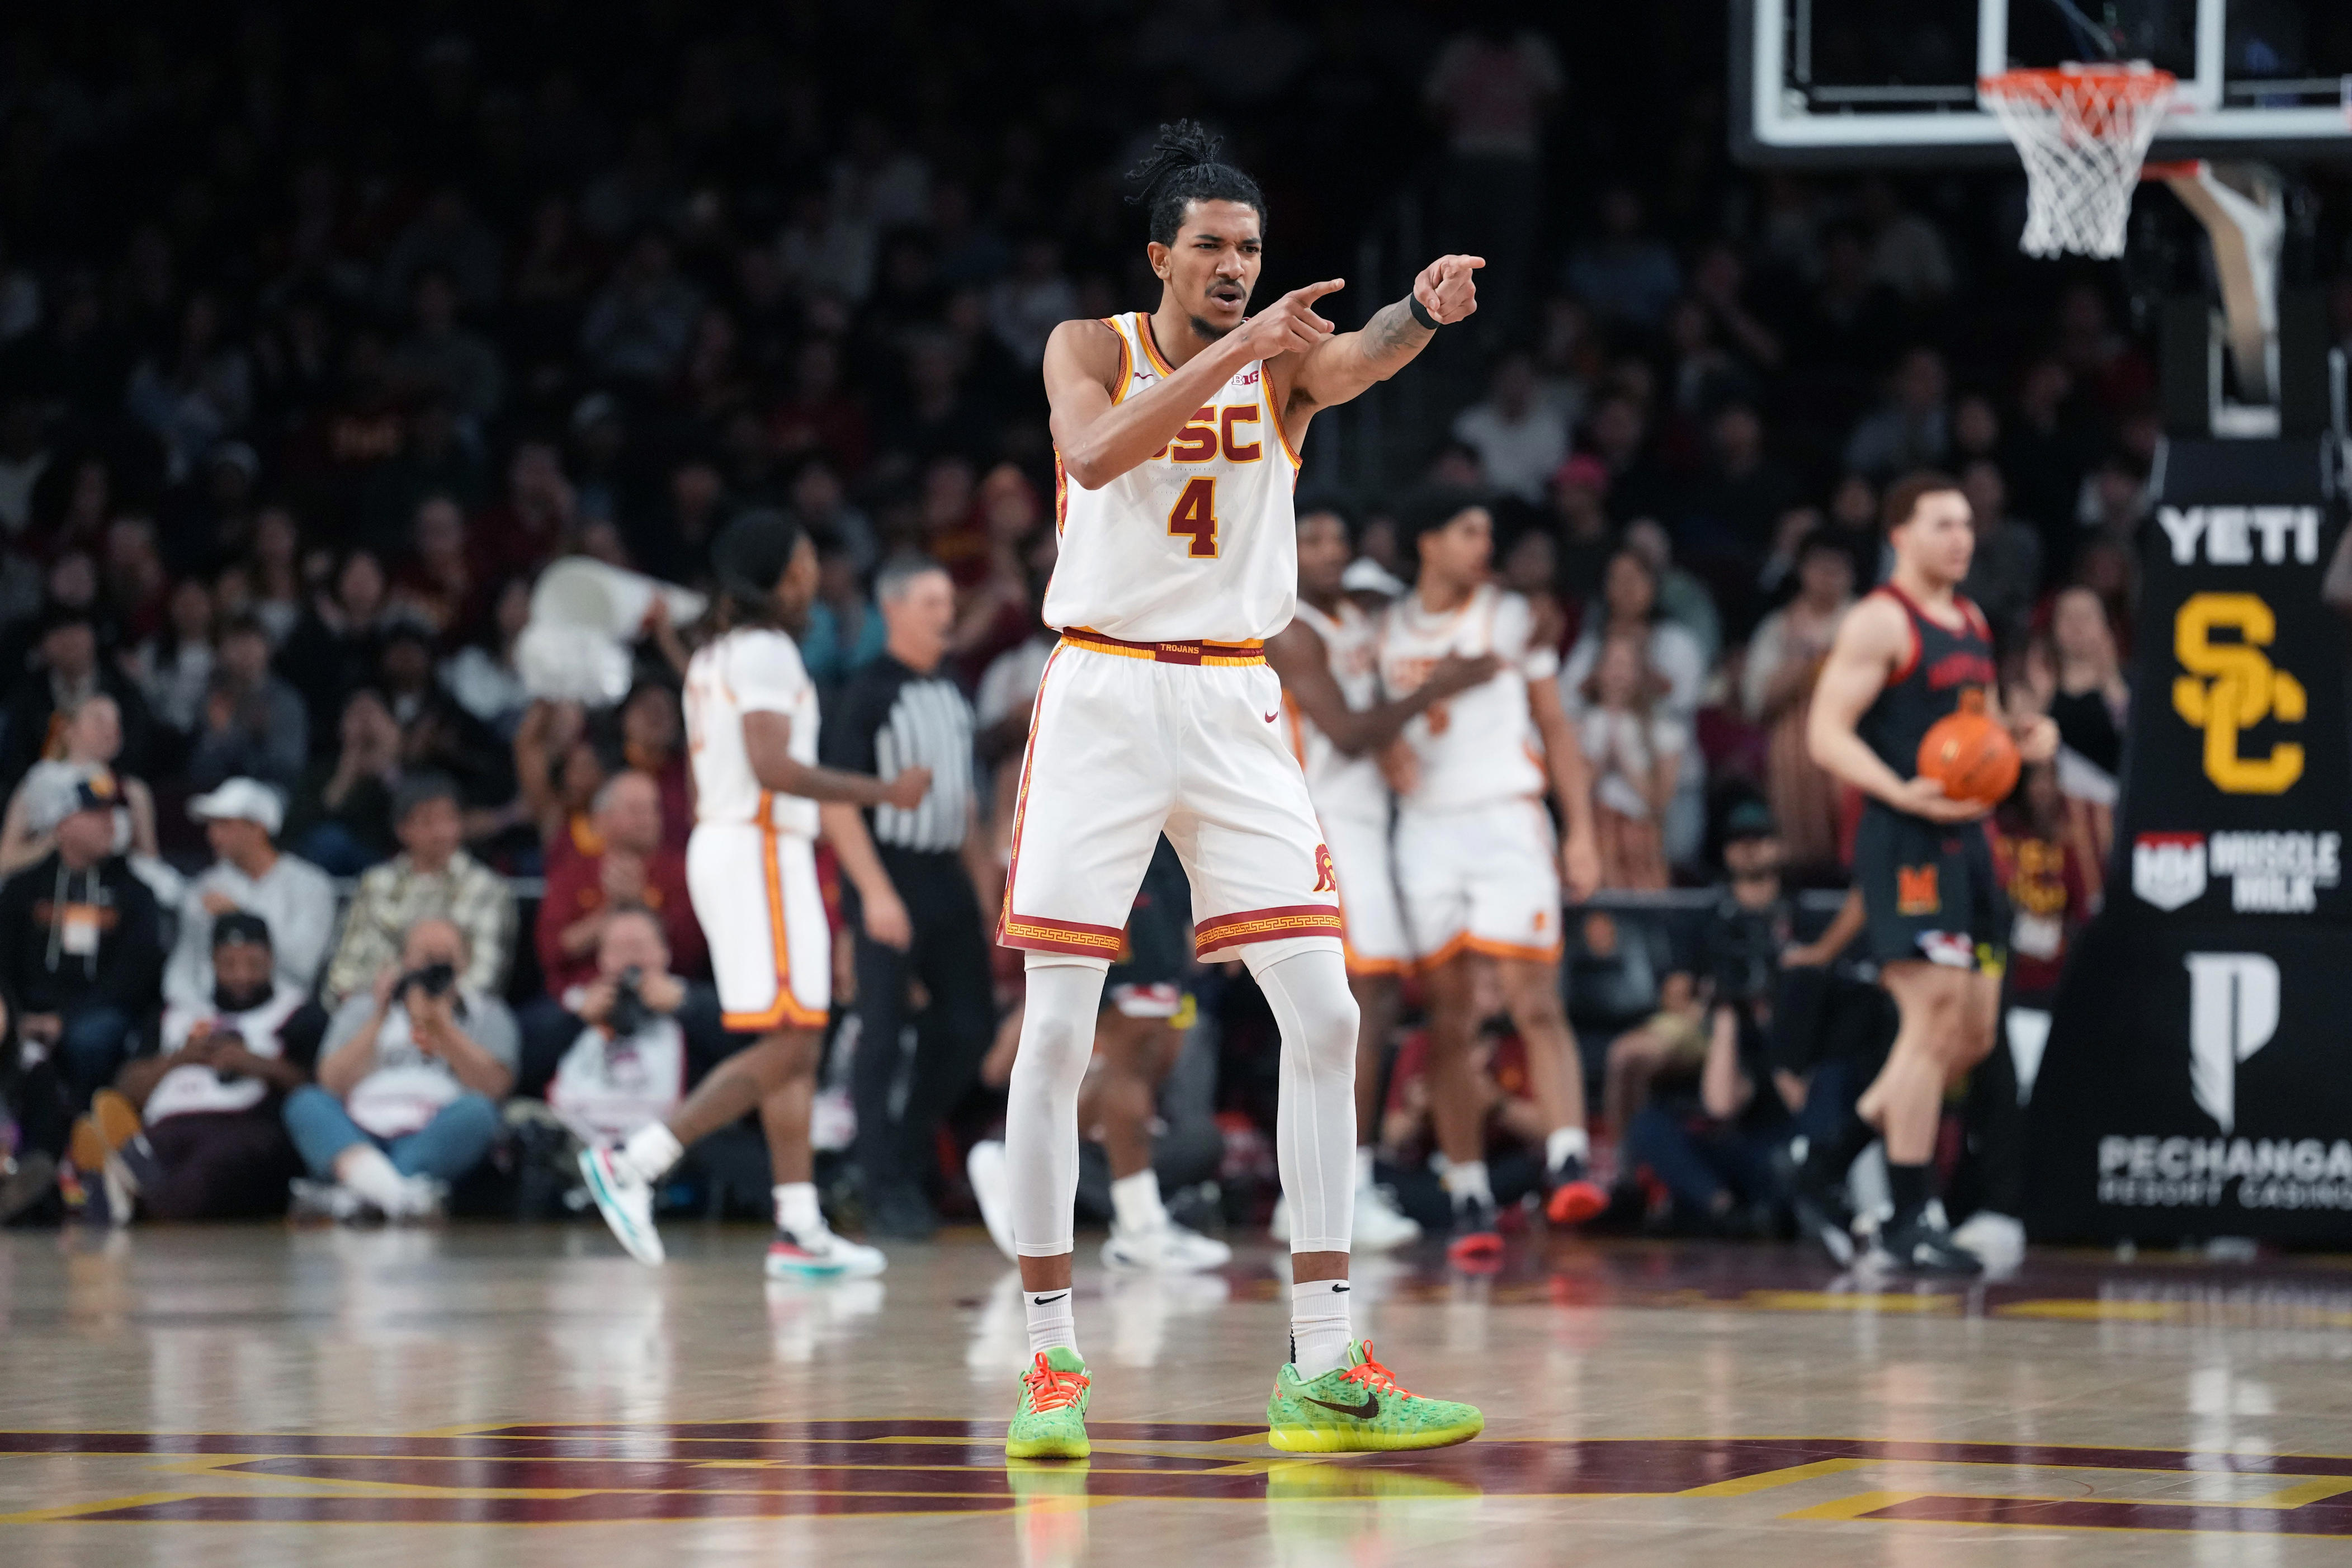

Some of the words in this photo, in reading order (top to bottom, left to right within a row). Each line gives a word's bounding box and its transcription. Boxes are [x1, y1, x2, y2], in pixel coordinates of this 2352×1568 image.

[1149, 403, 1263, 464] SC
[1168, 476, 1218, 559] 4
[2157, 505, 2319, 565] YETI
[1160, 643, 1199, 654] TROJANS
[2172, 591, 2307, 795] SC
[2209, 829, 2342, 888] MUSCLE
[2231, 876, 2317, 914] MILK
[2097, 1134, 2352, 1182] PECHANGA
